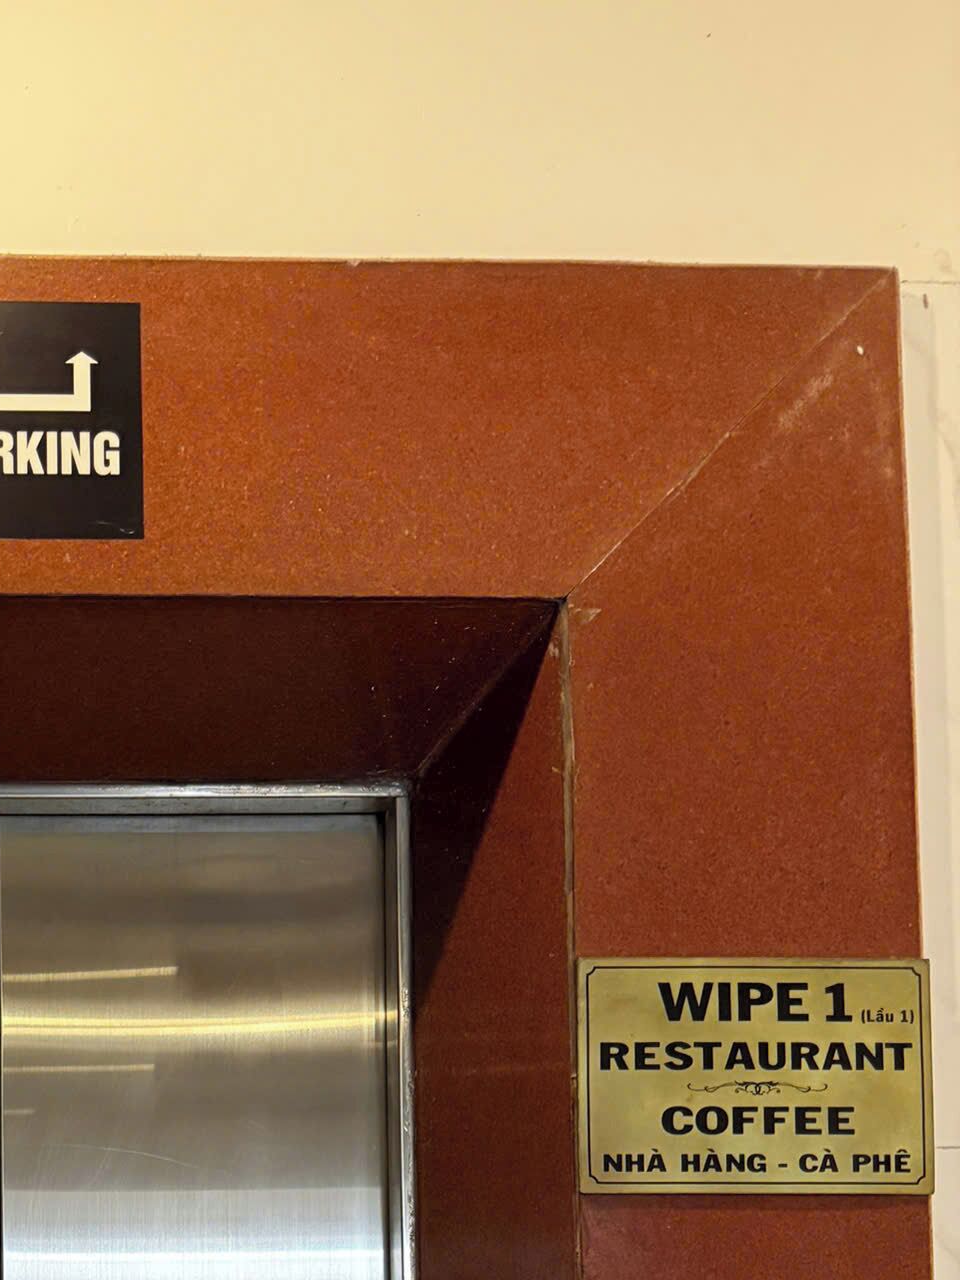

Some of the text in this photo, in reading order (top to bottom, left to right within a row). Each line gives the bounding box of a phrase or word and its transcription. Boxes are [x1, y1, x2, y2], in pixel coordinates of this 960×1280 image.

[658, 981, 915, 1025] WIPE 1 (Lầu 1)
[599, 1041, 913, 1071] RESTAURANT
[661, 1106, 856, 1136] COFFEE
[603, 1148, 667, 1173] NHÀ
[681, 1148, 767, 1173] HÀNG
[798, 1148, 839, 1173] CÀ
[852, 1149, 912, 1173] PHÊ
